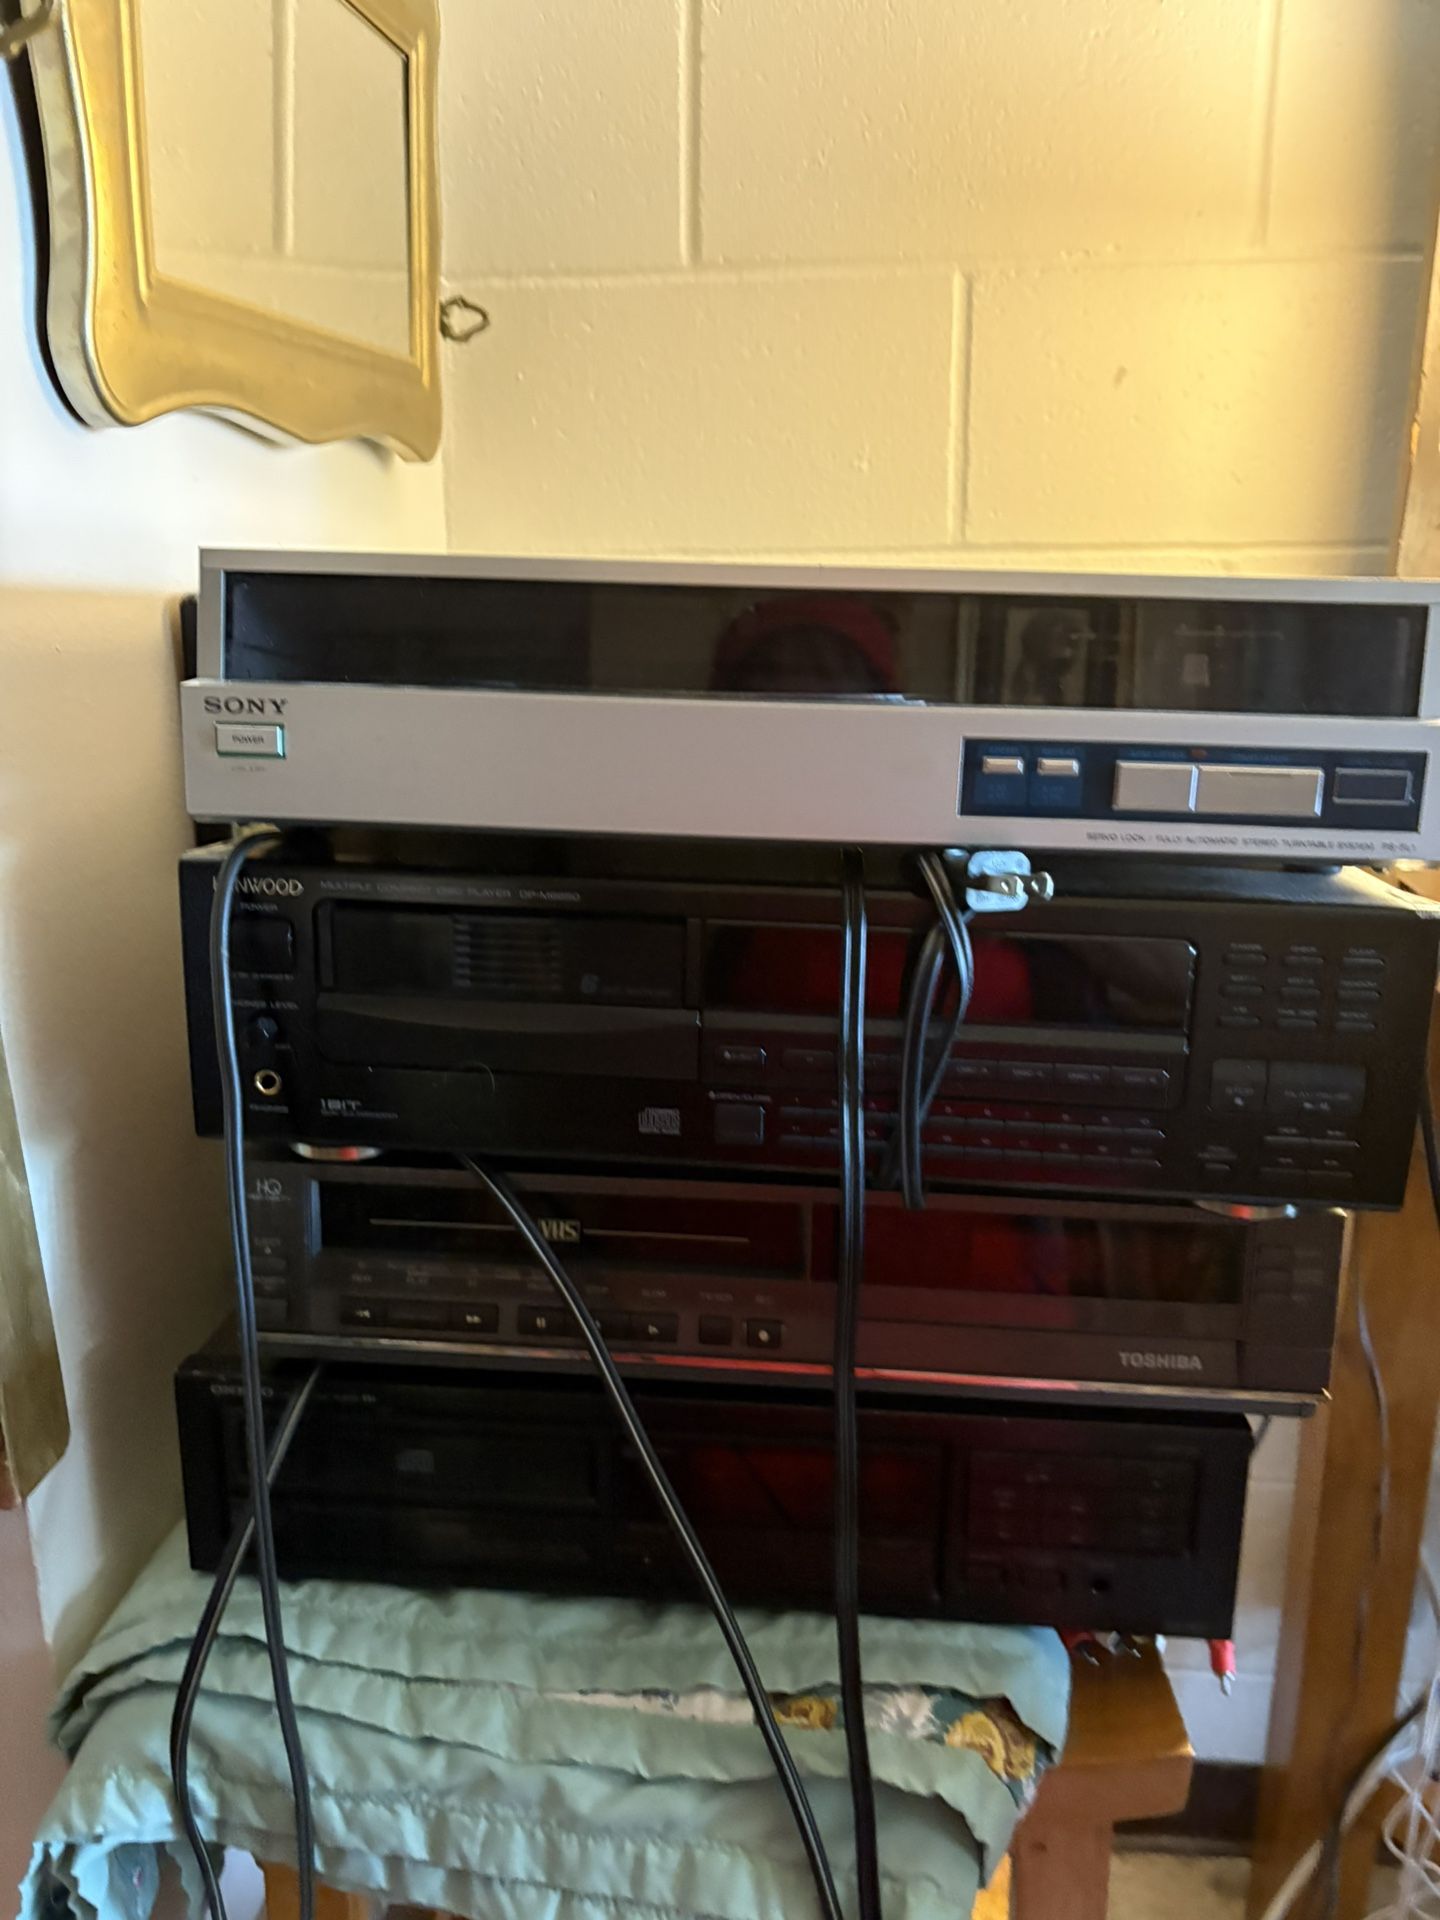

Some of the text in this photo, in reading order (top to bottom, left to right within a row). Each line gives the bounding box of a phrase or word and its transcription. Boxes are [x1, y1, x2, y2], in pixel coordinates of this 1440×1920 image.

[203, 696, 288, 714] SONY
[256, 1177, 283, 1197] HQ
[539, 1218, 578, 1241] VHS
[1118, 1351, 1203, 1371] TOSHIBA
